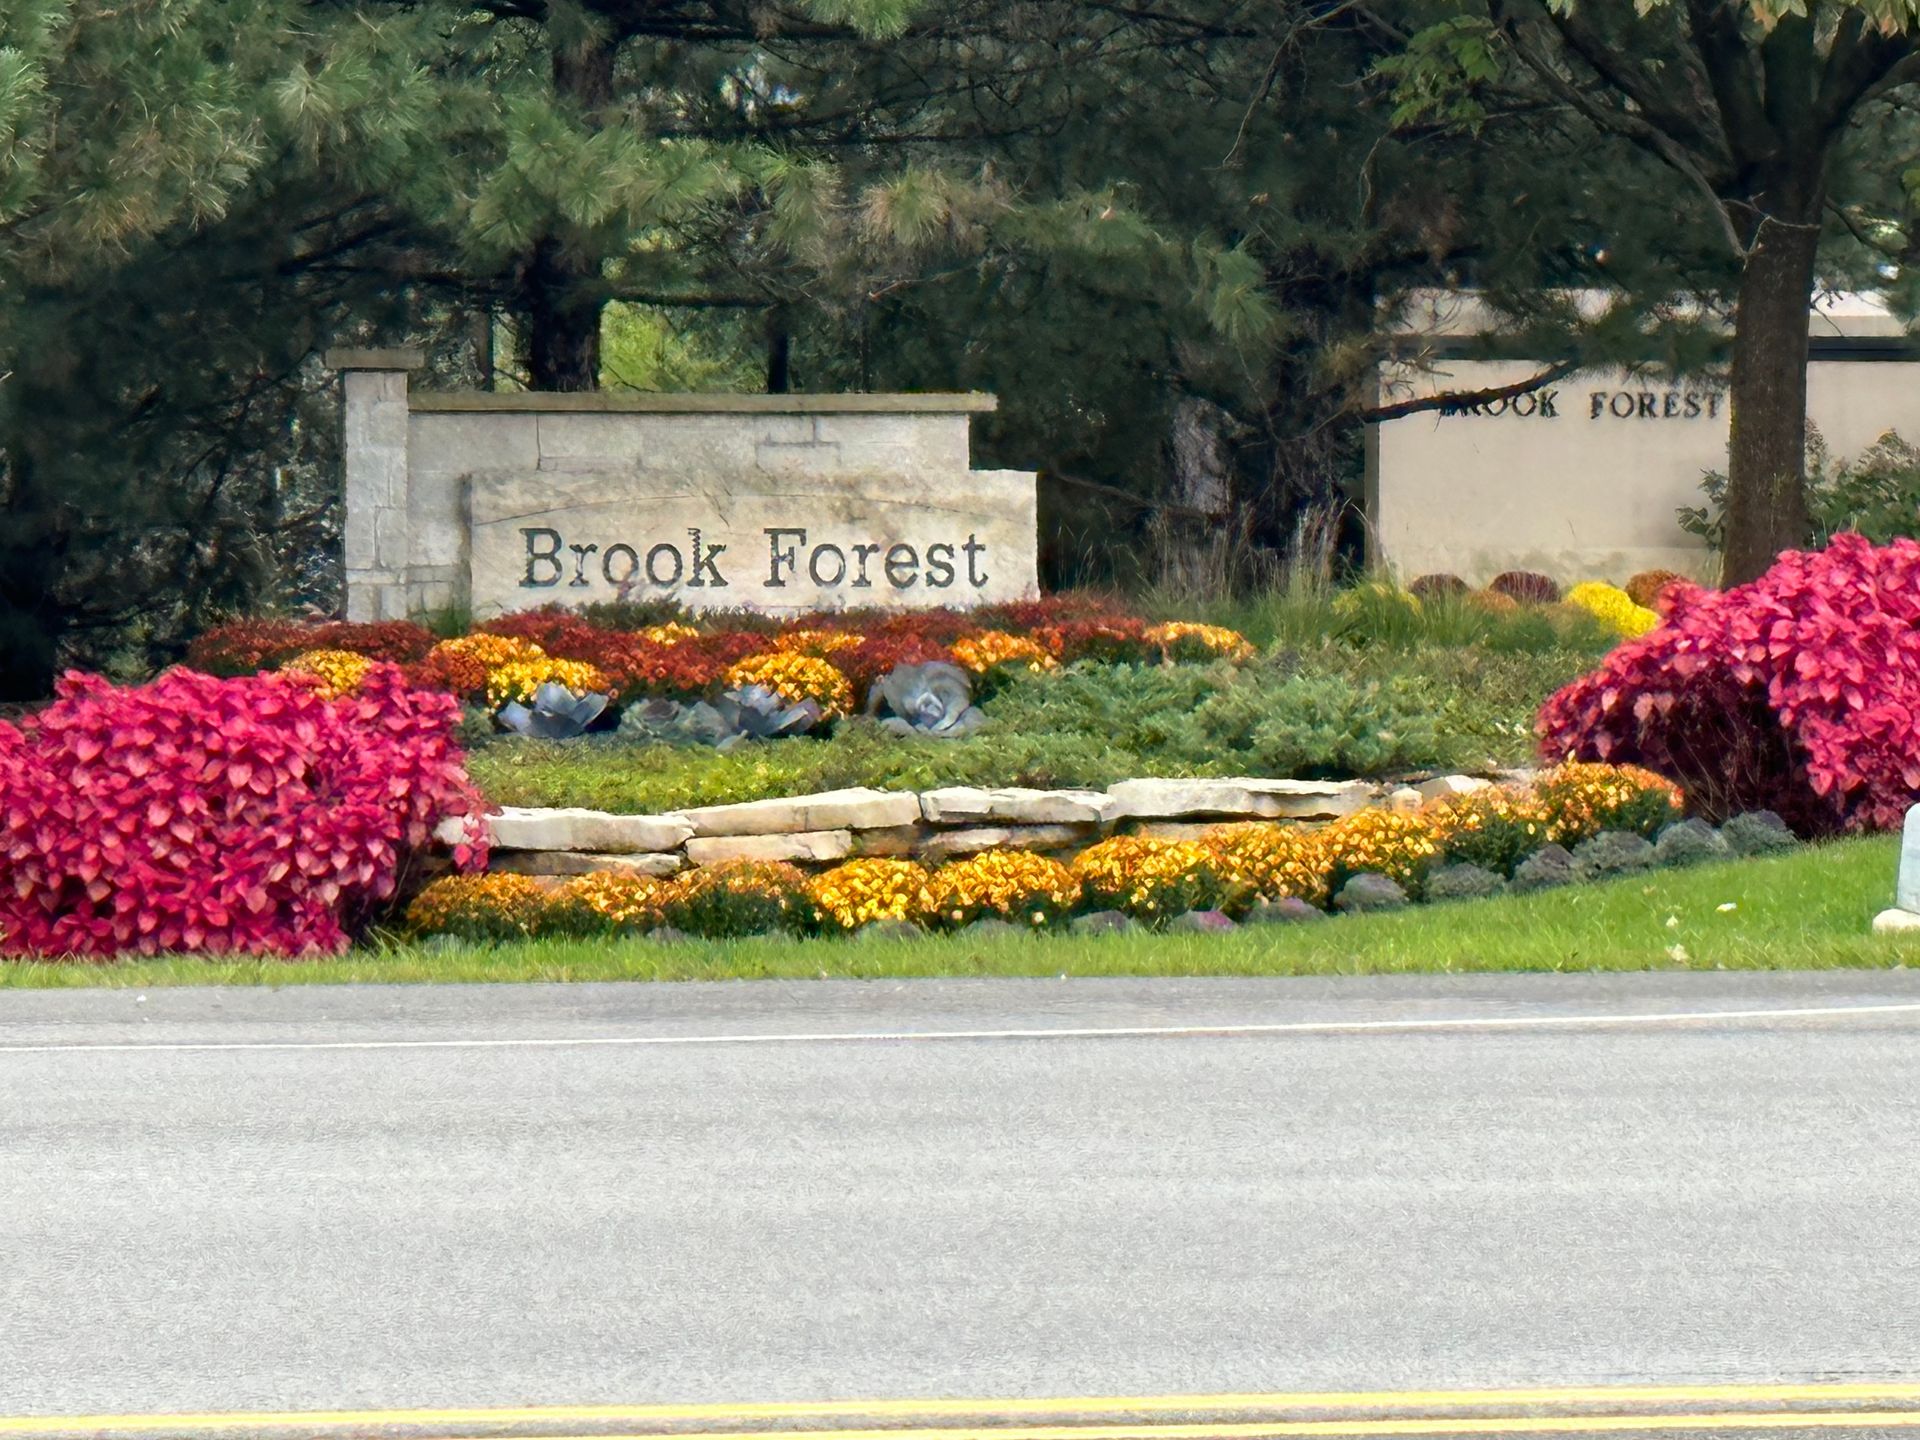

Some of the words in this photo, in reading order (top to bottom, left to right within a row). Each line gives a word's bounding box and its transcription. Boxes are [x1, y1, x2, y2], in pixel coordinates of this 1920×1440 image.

[1439, 390, 1560, 417] OOK
[1589, 391, 1723, 419] FOREST
[518, 527, 728, 588] Brook
[762, 527, 989, 588] Forest
